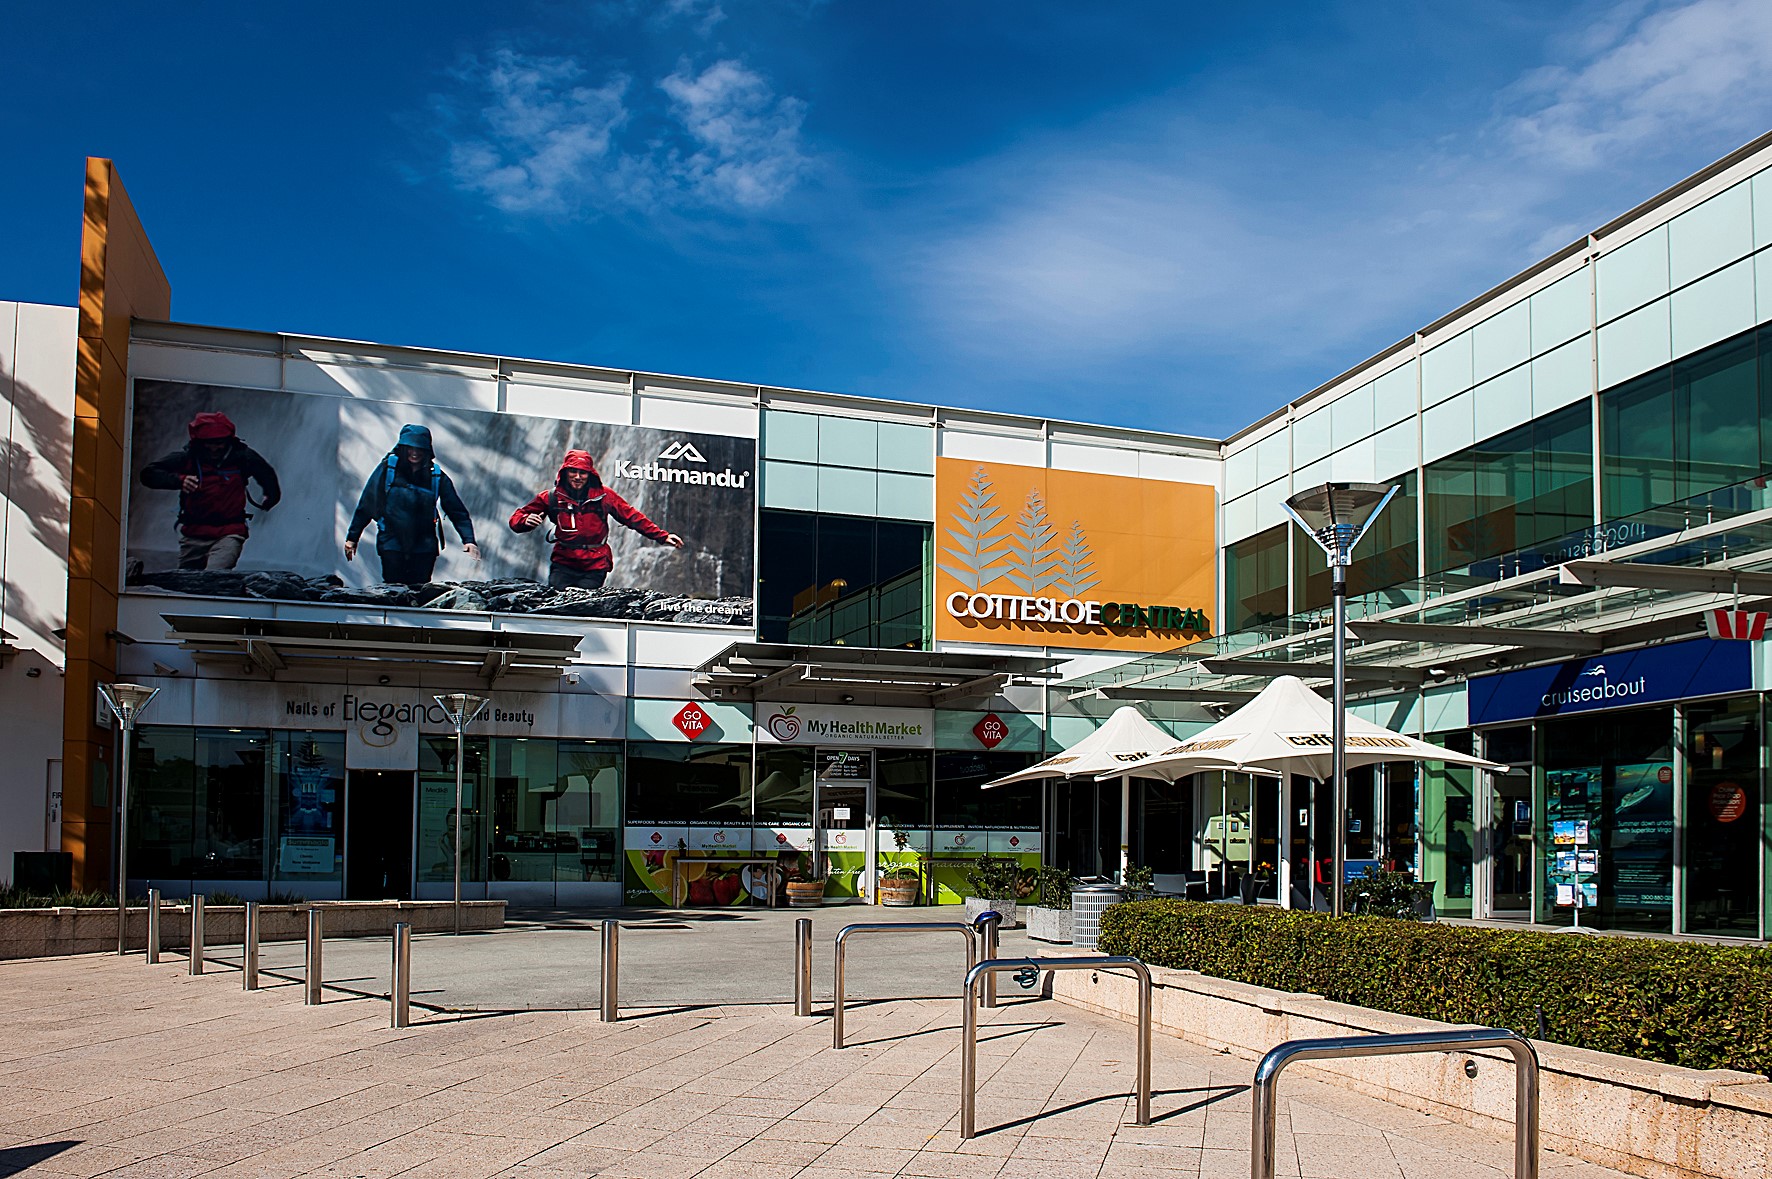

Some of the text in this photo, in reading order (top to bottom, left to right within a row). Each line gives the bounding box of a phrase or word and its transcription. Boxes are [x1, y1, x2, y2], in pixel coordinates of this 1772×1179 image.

[661, 602, 743, 615] live the dream
[1541, 677, 1646, 707] cruiseabout
[286, 701, 318, 716] Nails
[323, 702, 336, 716] of
[470, 708, 490, 721] nd
[495, 709, 534, 726] Beauty
[683, 710, 701, 720] GO
[681, 720, 703, 730] VITA
[984, 721, 1000, 730] GO
[983, 730, 1002, 739] VITA
[838, 751, 848, 764] 7
[52, 791, 62, 799] FIR
